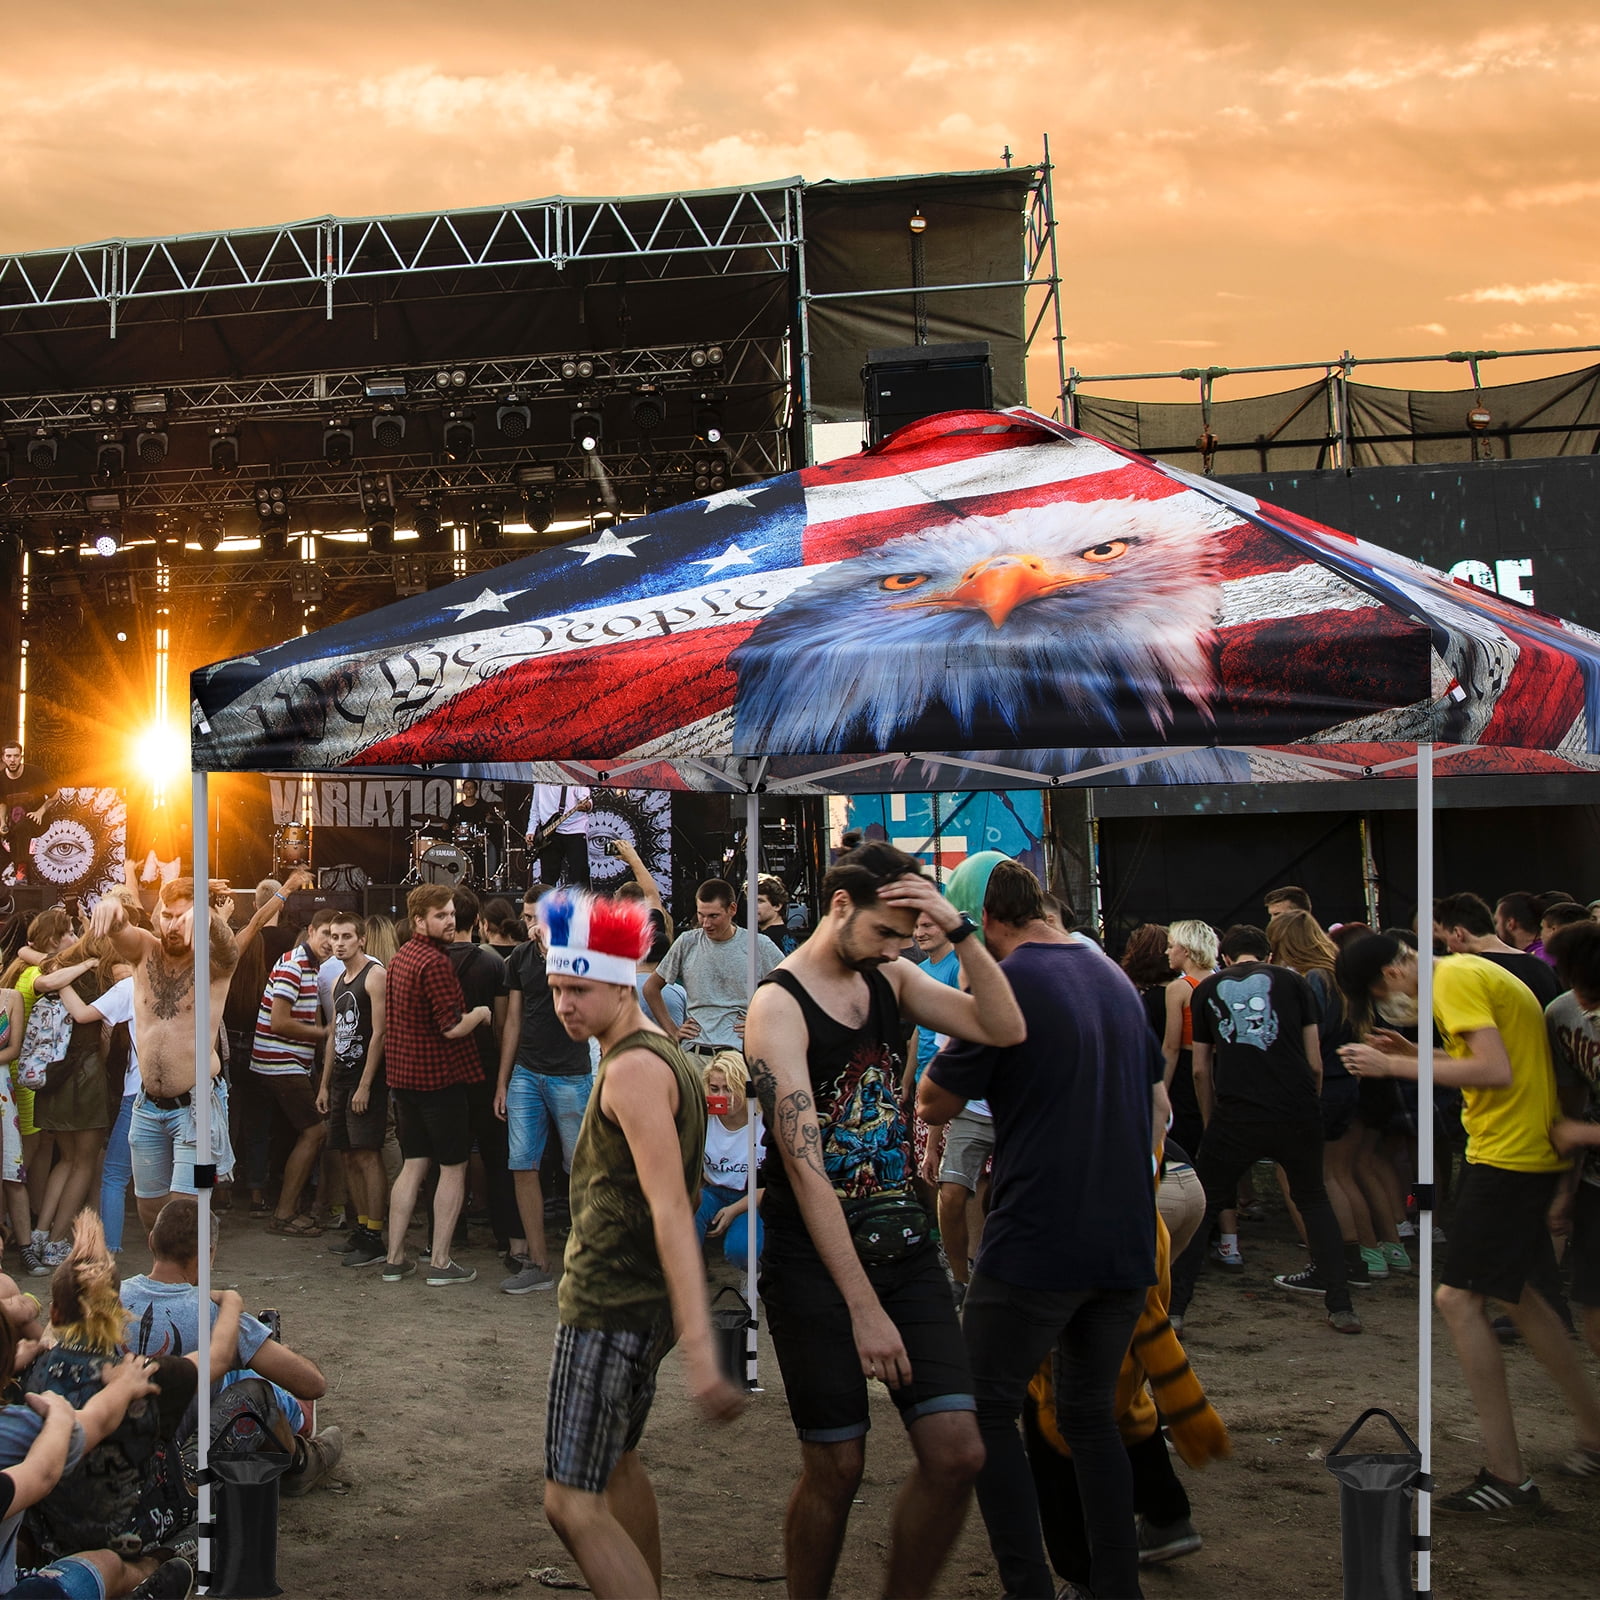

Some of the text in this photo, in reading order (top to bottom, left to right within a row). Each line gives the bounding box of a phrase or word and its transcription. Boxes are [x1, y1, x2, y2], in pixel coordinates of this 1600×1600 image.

[478, 587, 769, 682] People
[269, 778, 504, 828] VARIATIOS
[435, 849, 457, 857] YAMAHA
